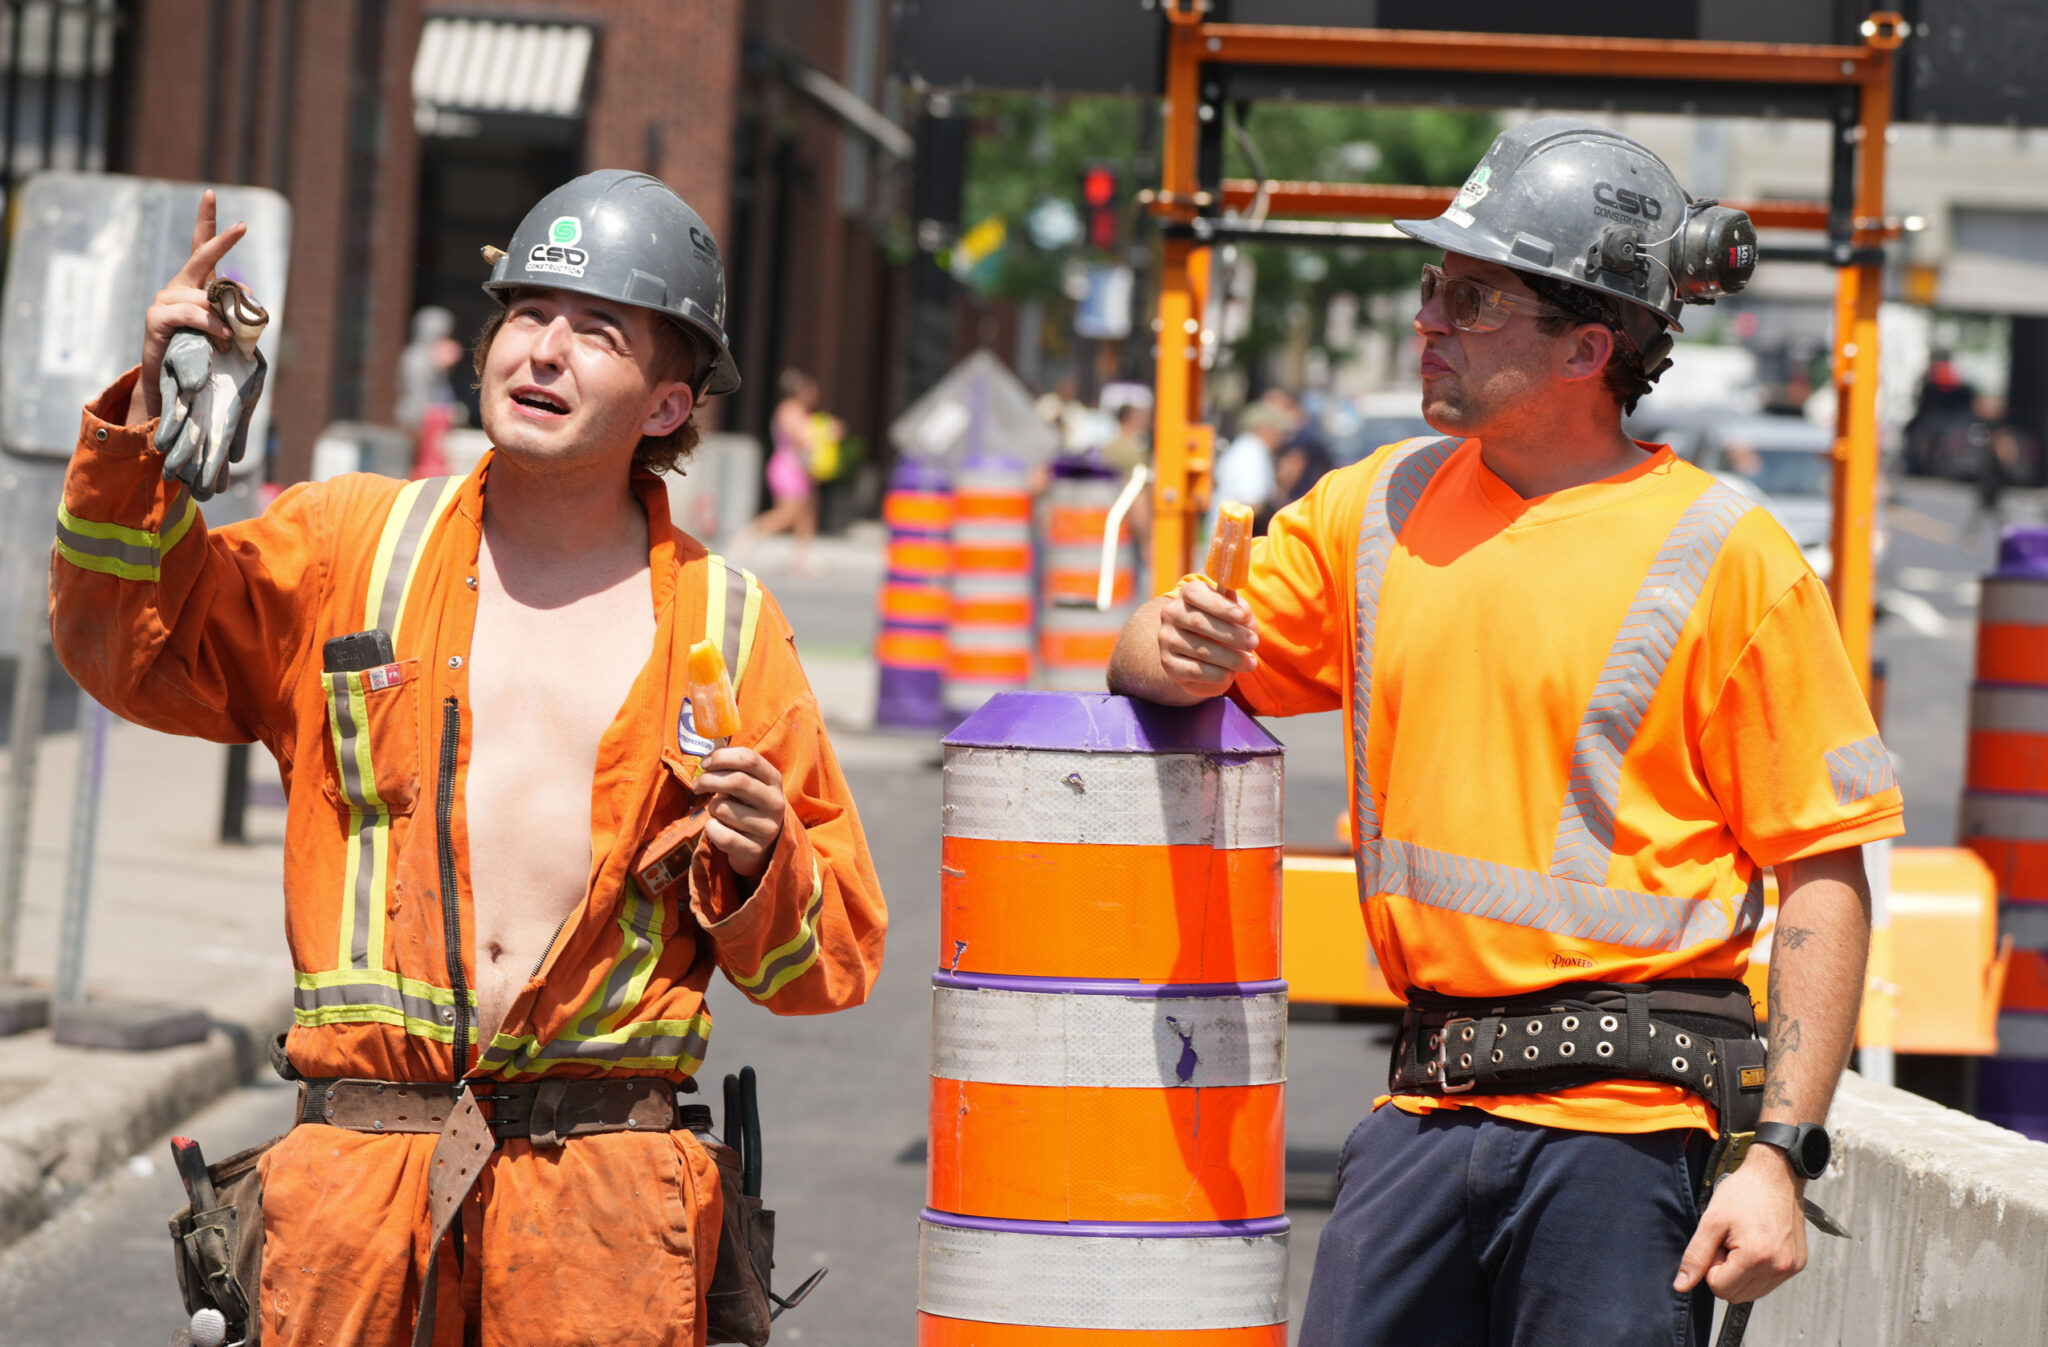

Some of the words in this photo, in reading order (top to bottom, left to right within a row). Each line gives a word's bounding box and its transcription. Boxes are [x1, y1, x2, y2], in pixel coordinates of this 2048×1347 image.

[1593, 182, 1662, 222] CSD
[689, 226, 718, 260] CS
[531, 246, 586, 266] CSD
[527, 263, 581, 276] CONSTRUCTION
[388, 671, 401, 680] FR
